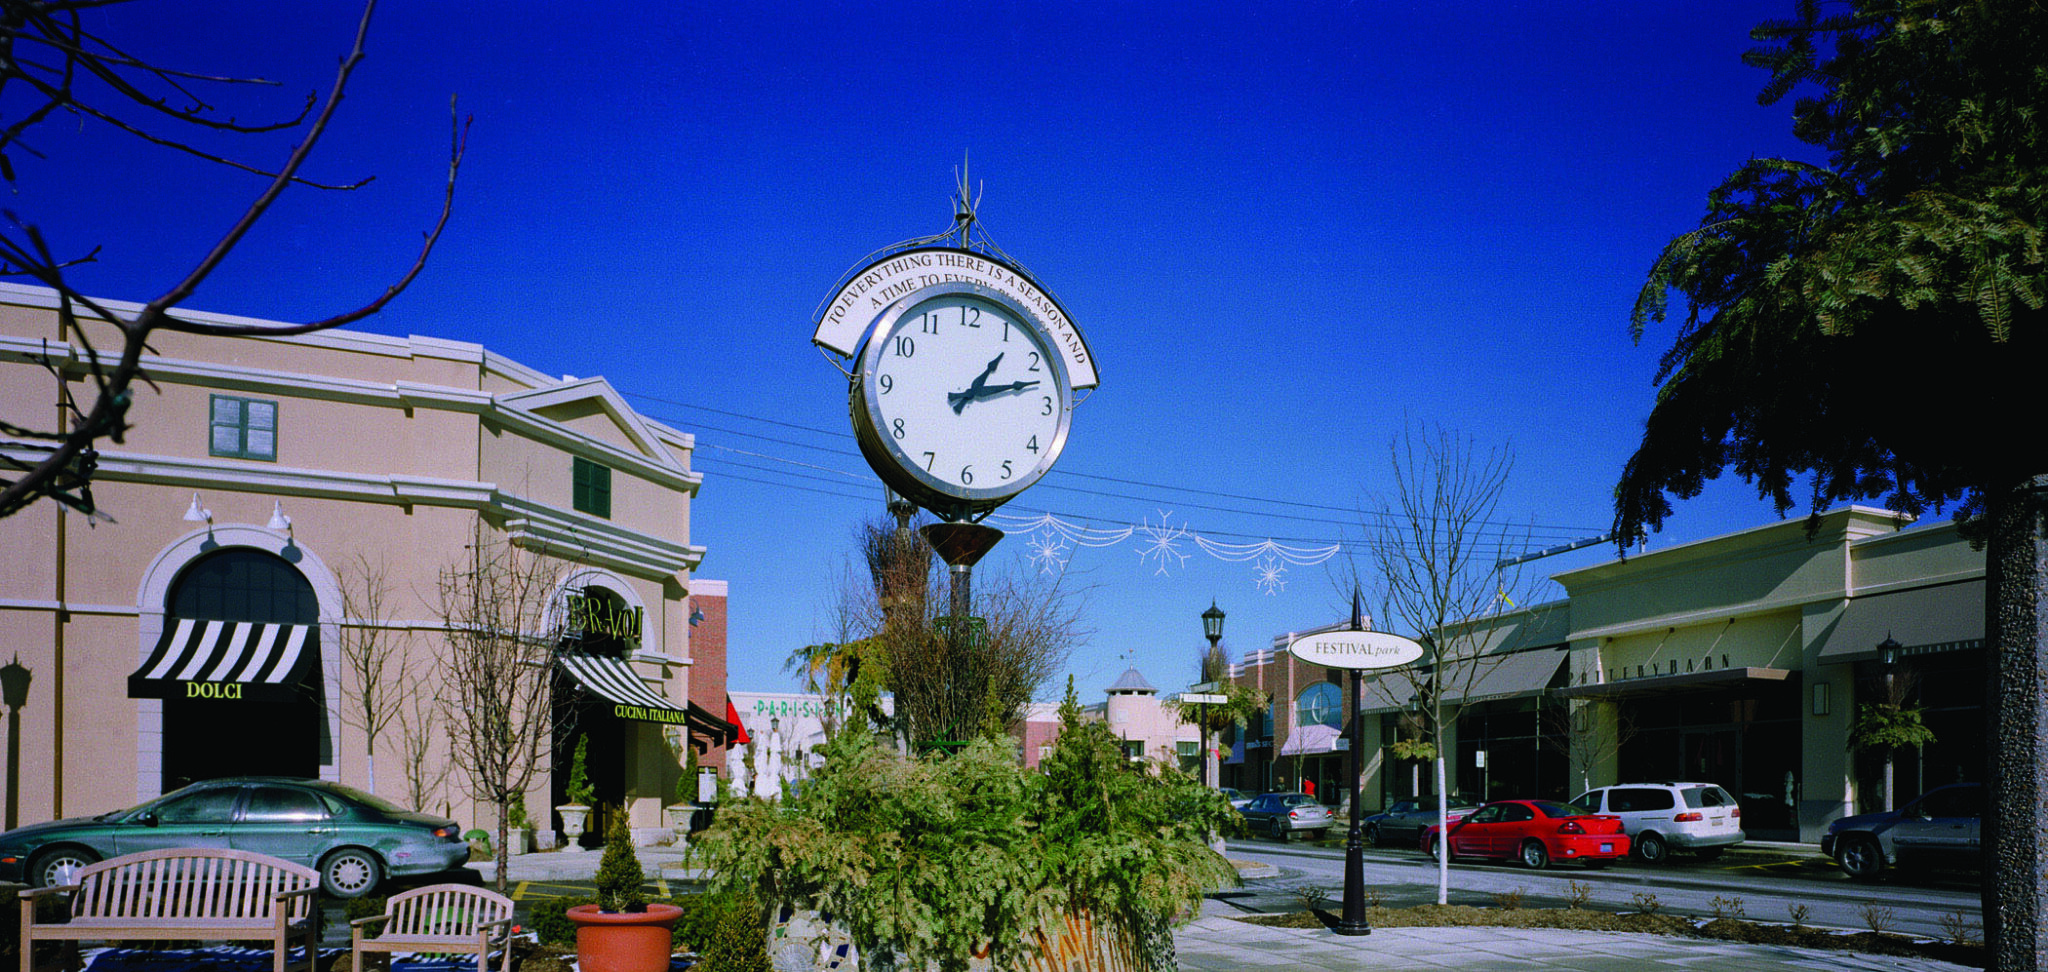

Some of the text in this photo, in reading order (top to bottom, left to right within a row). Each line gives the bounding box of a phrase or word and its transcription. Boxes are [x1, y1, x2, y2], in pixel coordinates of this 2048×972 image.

[870, 297, 882, 310] A
[879, 277, 917, 301] TIME
[918, 273, 939, 288] TO
[828, 305, 846, 325] TO
[841, 254, 932, 308] EVERYTHING
[935, 253, 985, 273] THERE
[987, 264, 1004, 280] IS
[1005, 275, 1016, 287] A
[1017, 281, 1067, 330] SEASON
[1062, 332, 1086, 364] AND
[960, 305, 981, 329] 12
[922, 312, 939, 335] 11
[1003, 322, 1009, 342] 1
[895, 335, 915, 358] 10
[1028, 351, 1040, 371] 2
[880, 374, 893, 395] 9
[1041, 396, 1052, 416] 3
[893, 418, 905, 440] 8
[1026, 434, 1039, 454] 4
[923, 451, 935, 472] 7
[1001, 460, 1013, 480] 5
[961, 464, 973, 485] 6
[186, 681, 242, 699] DOLCI
[614, 704, 686, 724] CUCINA ITALIANA
